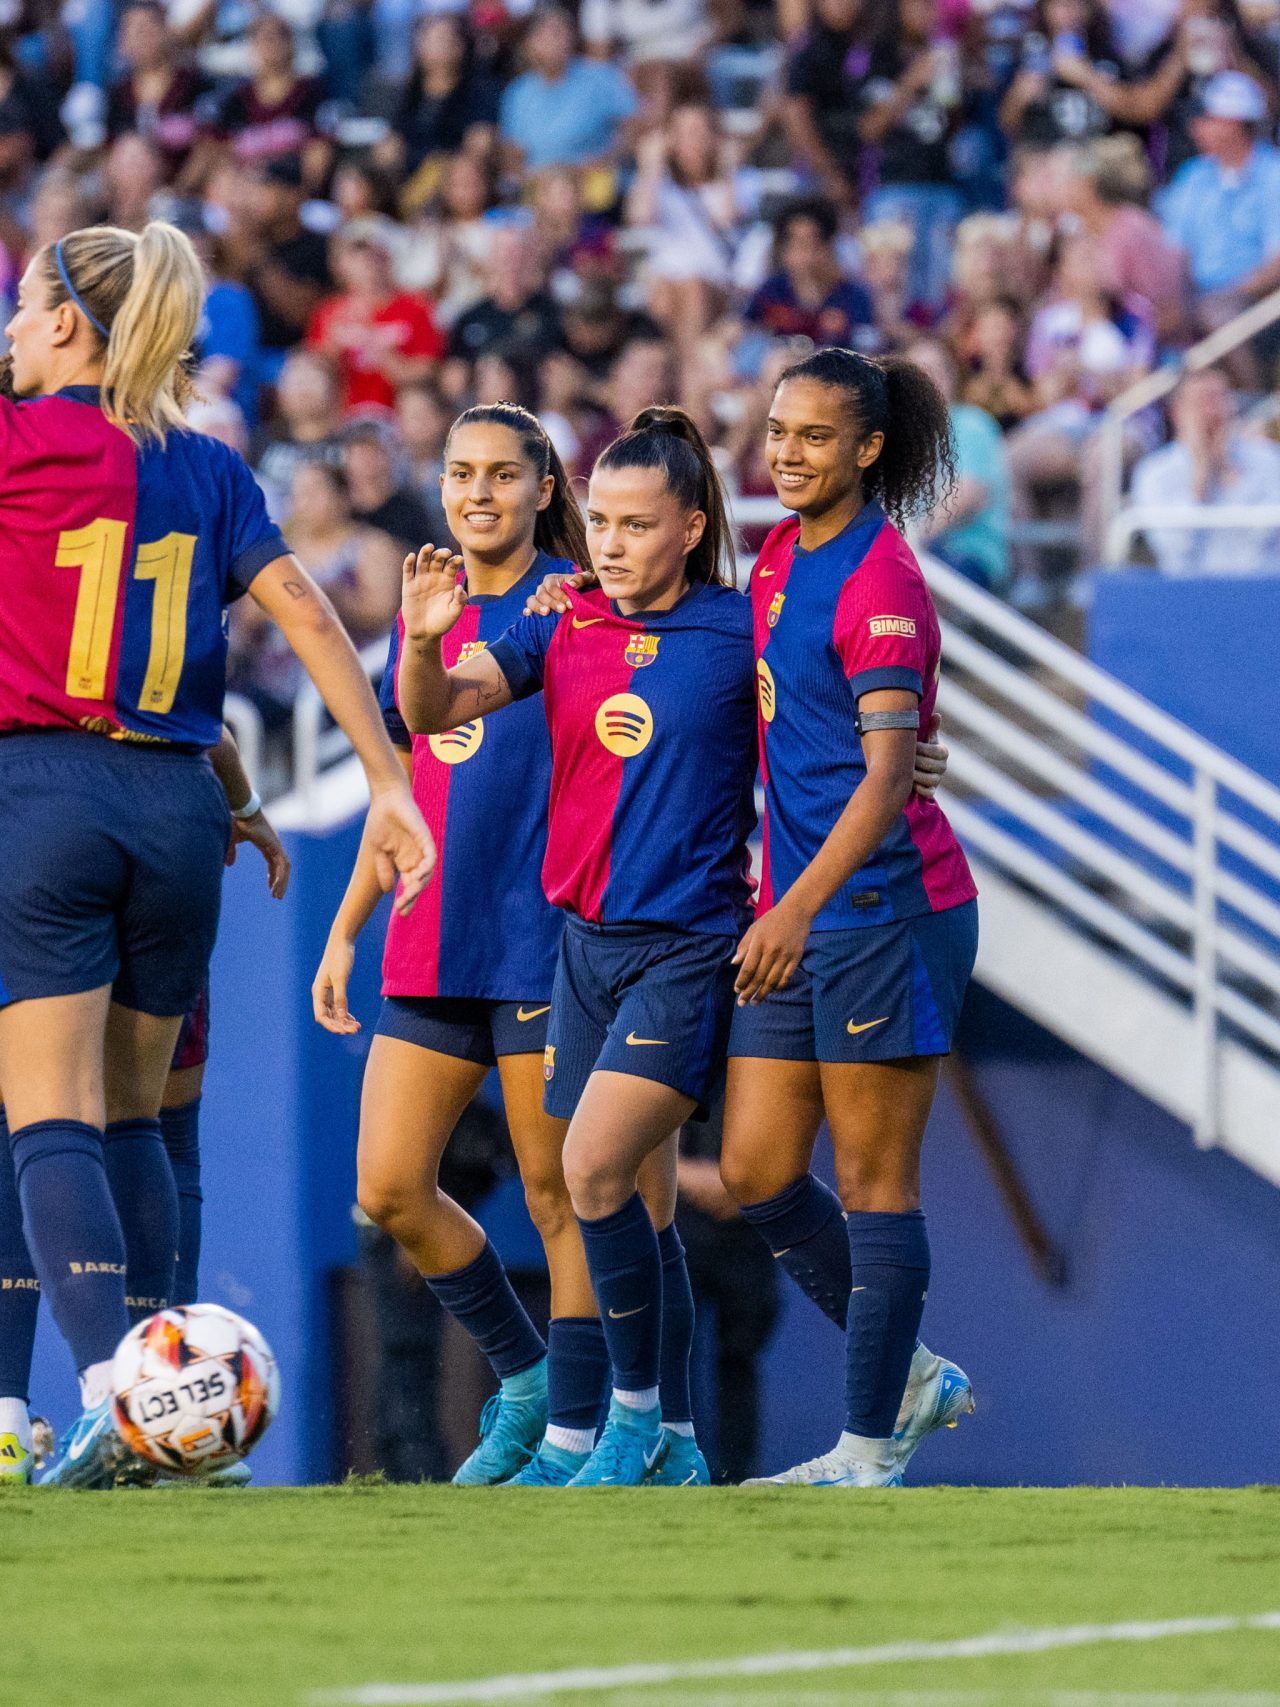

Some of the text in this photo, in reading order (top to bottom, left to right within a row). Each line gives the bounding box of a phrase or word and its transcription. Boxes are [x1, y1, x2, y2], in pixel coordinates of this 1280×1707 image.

[55, 517, 198, 714] 11
[870, 619, 916, 634] BIMBO
[1, 1278, 40, 1291] BARC
[123, 1296, 168, 1310] ARCA
[138, 1371, 225, 1423] SELECT
